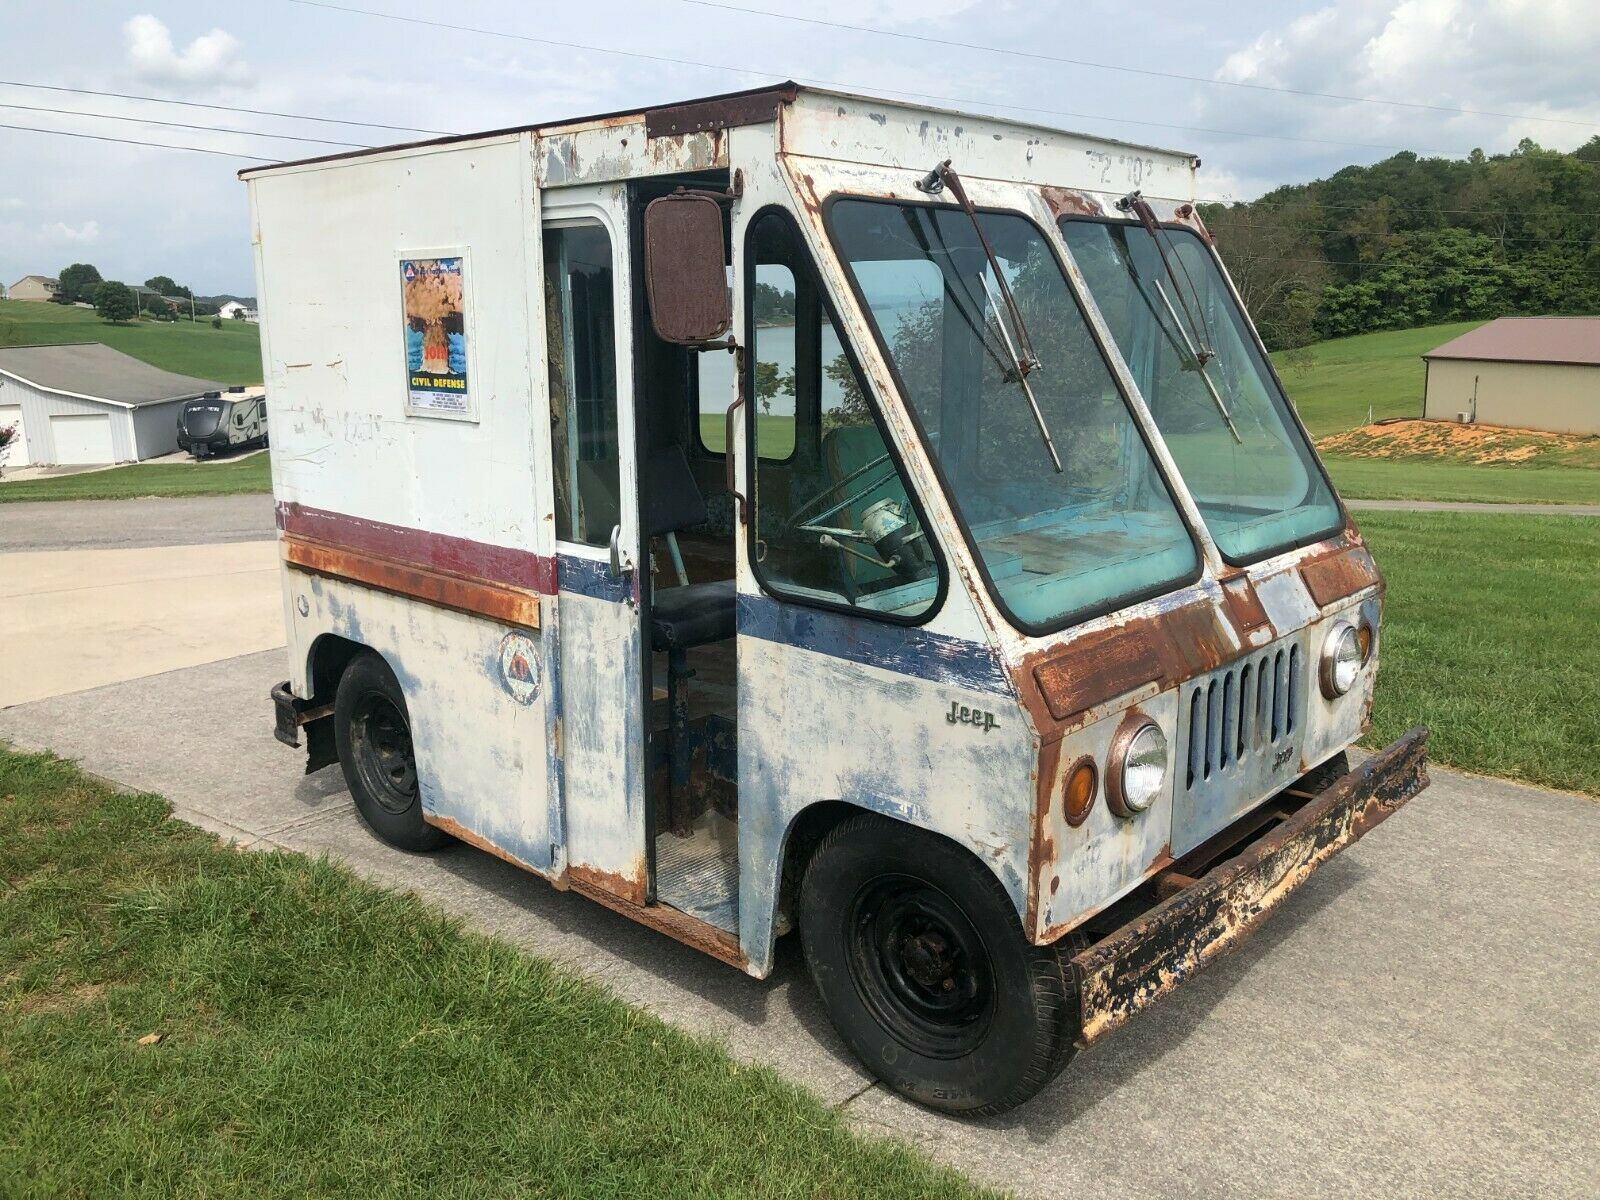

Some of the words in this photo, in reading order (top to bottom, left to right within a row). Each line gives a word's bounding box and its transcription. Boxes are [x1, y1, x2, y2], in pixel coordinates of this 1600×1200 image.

[424, 346, 449, 360] JOIN
[411, 377, 431, 387] CIVIL
[433, 378, 465, 389] DEFENSE
[945, 701, 1001, 732] Jeep
